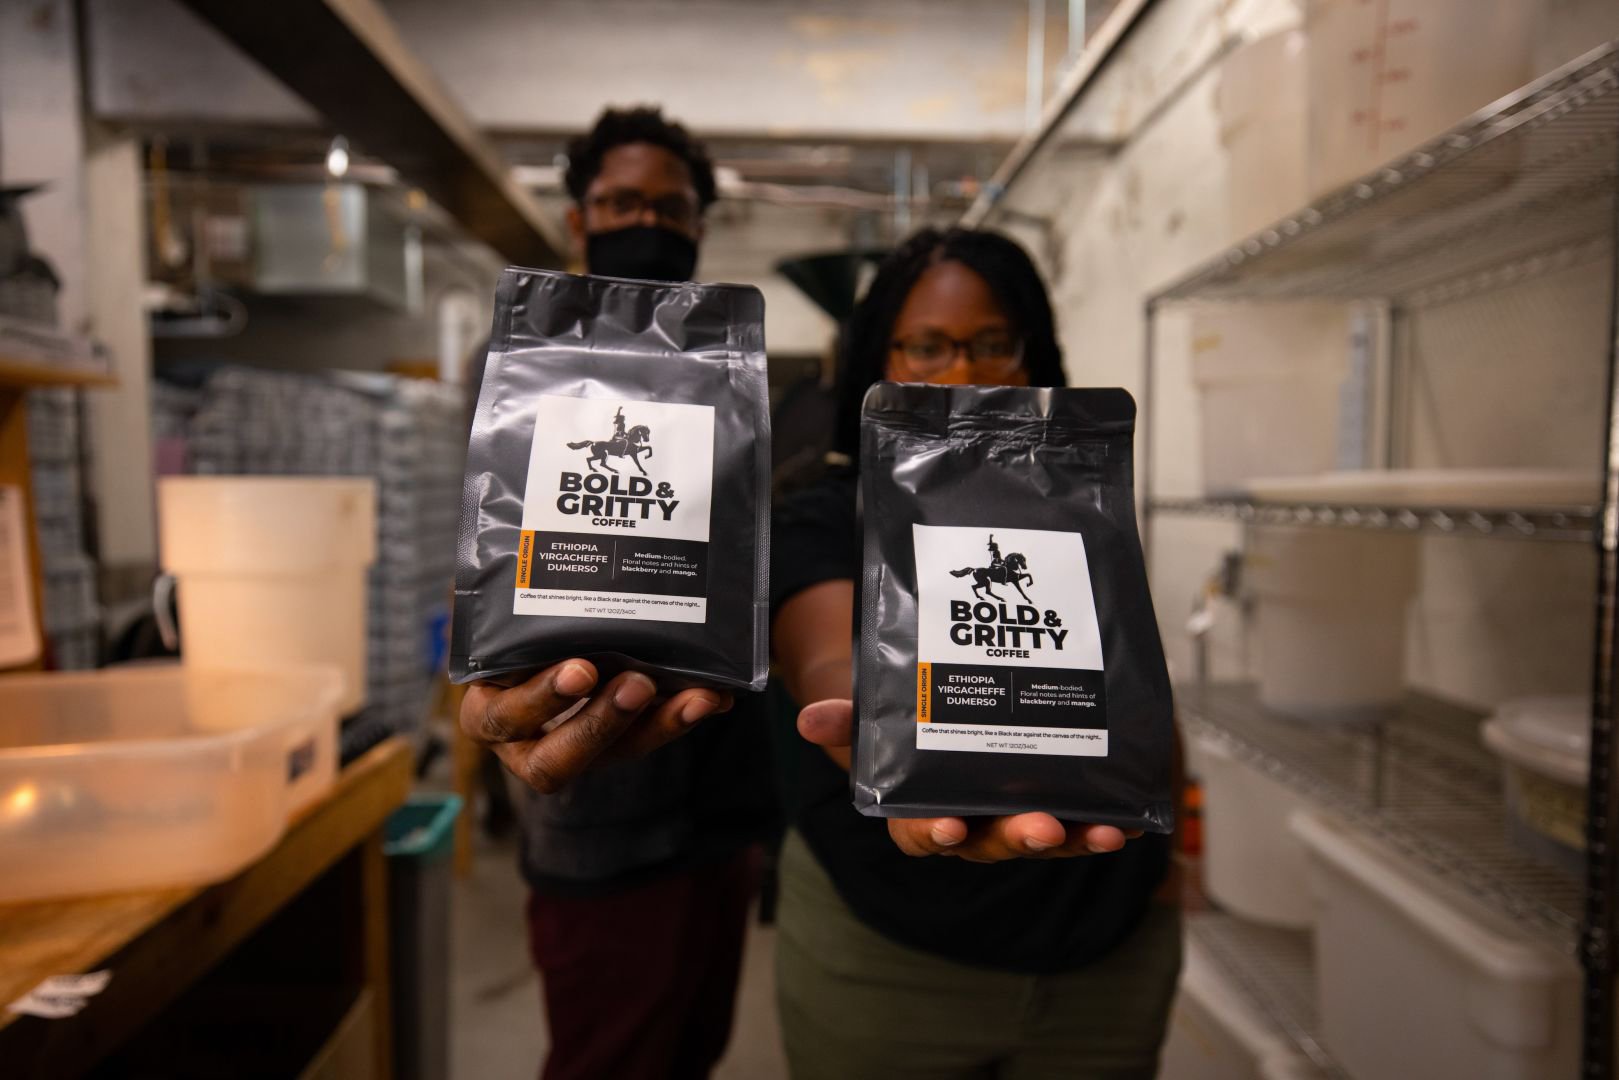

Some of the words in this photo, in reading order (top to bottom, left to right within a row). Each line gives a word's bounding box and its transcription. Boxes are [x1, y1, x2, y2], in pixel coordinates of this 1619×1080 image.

[559, 471, 653, 497] BOLD
[655, 481, 675, 499] &
[556, 492, 680, 521] GRITTY
[591, 517, 636, 528] COFFEE
[522, 535, 530, 559] ORIGIN
[551, 542, 598, 552] ETHIOPIA
[539, 552, 608, 563] YIRGACHEFFE
[520, 559, 528, 584] SINGLE
[547, 563, 598, 573] DUMERSO
[621, 565, 657, 574] blackberry
[950, 599, 1040, 627] BOLD
[1043, 609, 1062, 628] &
[949, 622, 1069, 651] GRITTY
[985, 648, 1030, 659] COFFEE
[948, 675, 996, 685] ETHIOPIA
[937, 685, 1006, 696] YIRGACHEFFE
[946, 696, 997, 706] DUMERSO
[1019, 697, 1056, 706] blackberry
[1070, 700, 1097, 708] mango.
